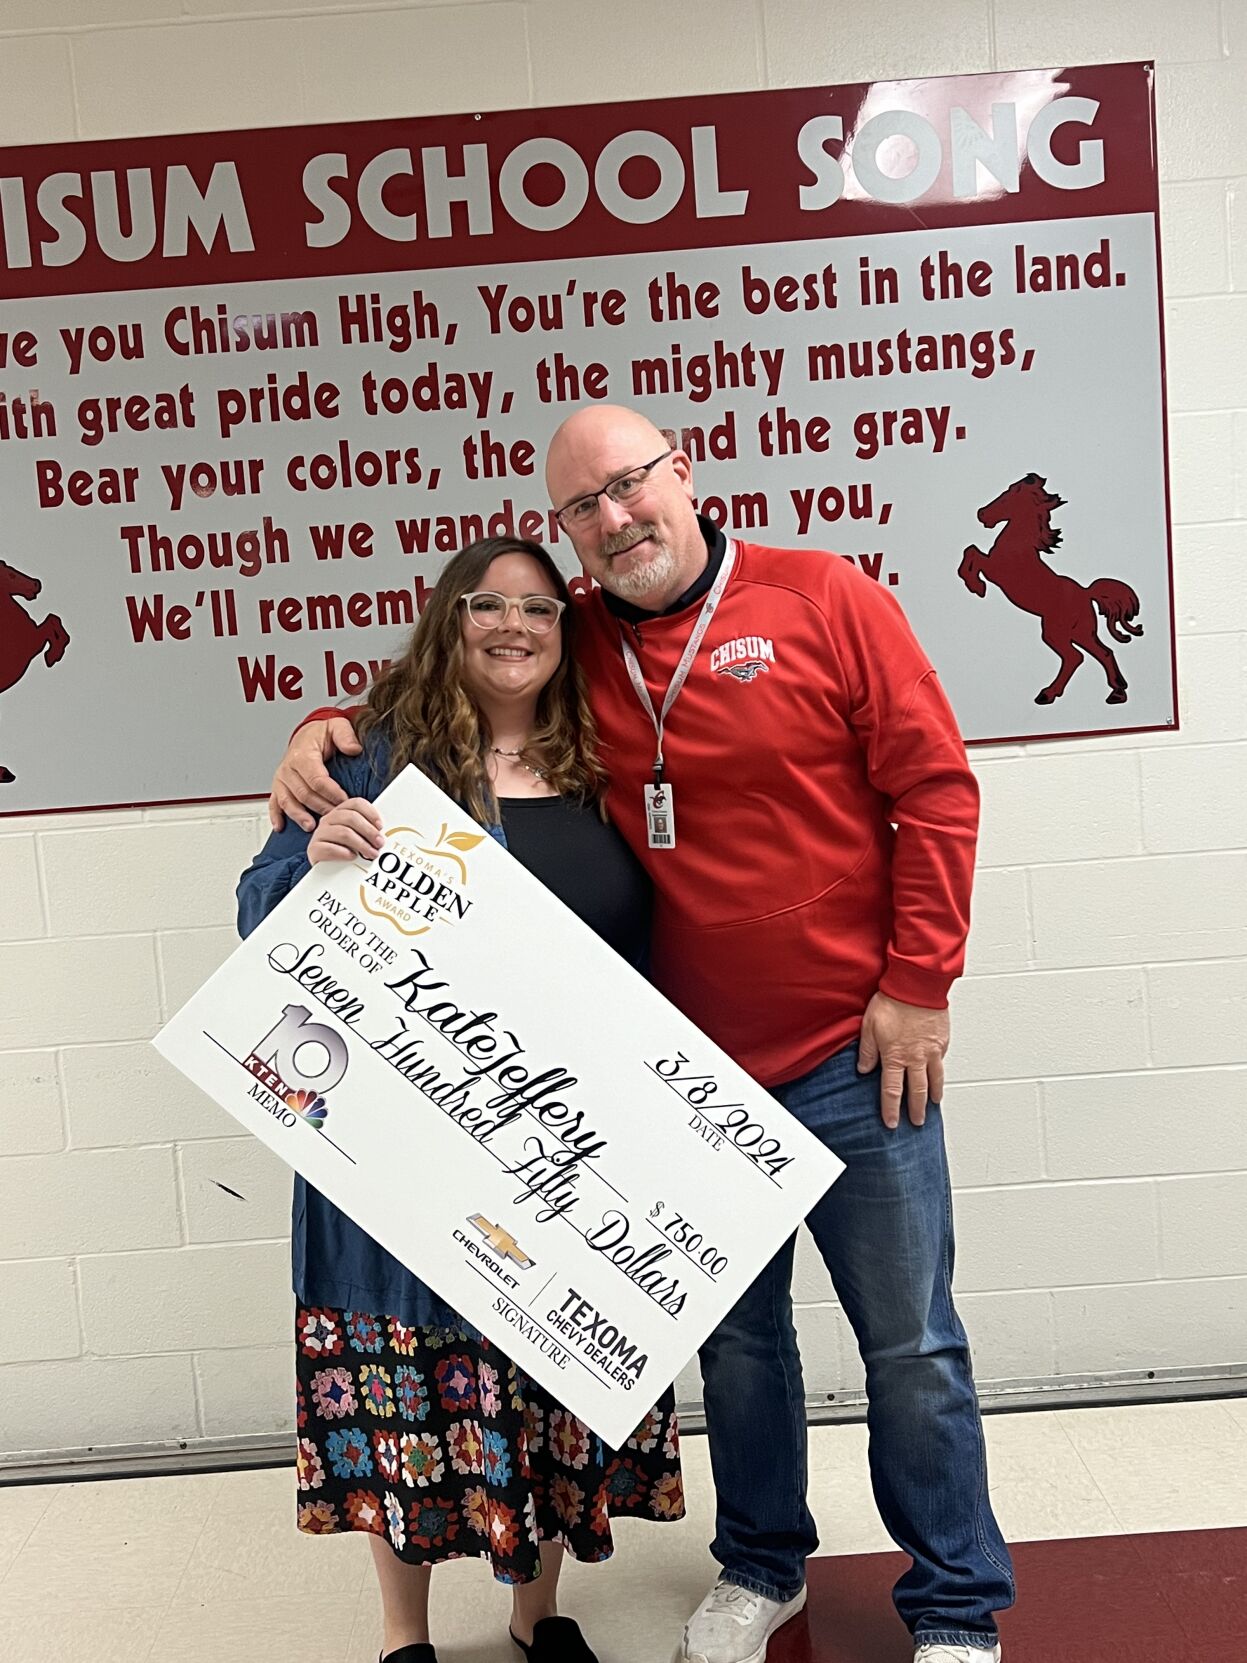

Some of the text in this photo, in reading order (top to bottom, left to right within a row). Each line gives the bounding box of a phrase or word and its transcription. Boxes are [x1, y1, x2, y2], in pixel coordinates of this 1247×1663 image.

[0, 96, 1105, 269] ISUM SCHOOL SONG
[59, 323, 144, 374] you
[164, 304, 318, 356] Chisum
[339, 290, 458, 353] High,
[477, 279, 626, 335] You're
[649, 271, 720, 322] the
[742, 262, 838, 315] best
[859, 257, 899, 306] in
[920, 250, 993, 302] the
[1015, 239, 1126, 294] land.
[0, 328, 1035, 446] ith great pride today, the mighty mustangs,
[36, 460, 139, 508] Bear
[161, 459, 264, 510] your
[287, 440, 441, 492] colors,
[463, 430, 535, 480] the
[758, 407, 831, 456] the
[854, 406, 966, 460] gray.
[121, 483, 892, 577] Though we wander om you,
[126, 589, 237, 643] We'll
[259, 576, 435, 634] rememb
[237, 654, 303, 702] We
[710, 636, 776, 672] CHISUM
[358, 851, 474, 920] OLDEN
[365, 872, 439, 922] APPLE
[393, 842, 455, 884] TEXOMA'S
[309, 908, 383, 974] ORDER OF
[317, 890, 398, 965] PAY TO THE
[375, 896, 411, 922] AWARD
[244, 1055, 290, 1095] KTEN
[246, 1083, 297, 1128] MEMO
[268, 943, 690, 1320] Seven Hundred Fifty Dollars
[655, 1050, 796, 1177] 3/8/2024
[687, 1114, 726, 1152] DATE
[452, 1229, 520, 1290] CHEVROLET
[649, 1201, 729, 1276] $ 750.00
[491, 1297, 571, 1371] SIGNATURE
[546, 1310, 636, 1391] CHEVY DEALERS
[557, 1288, 649, 1380] TEXOMA
